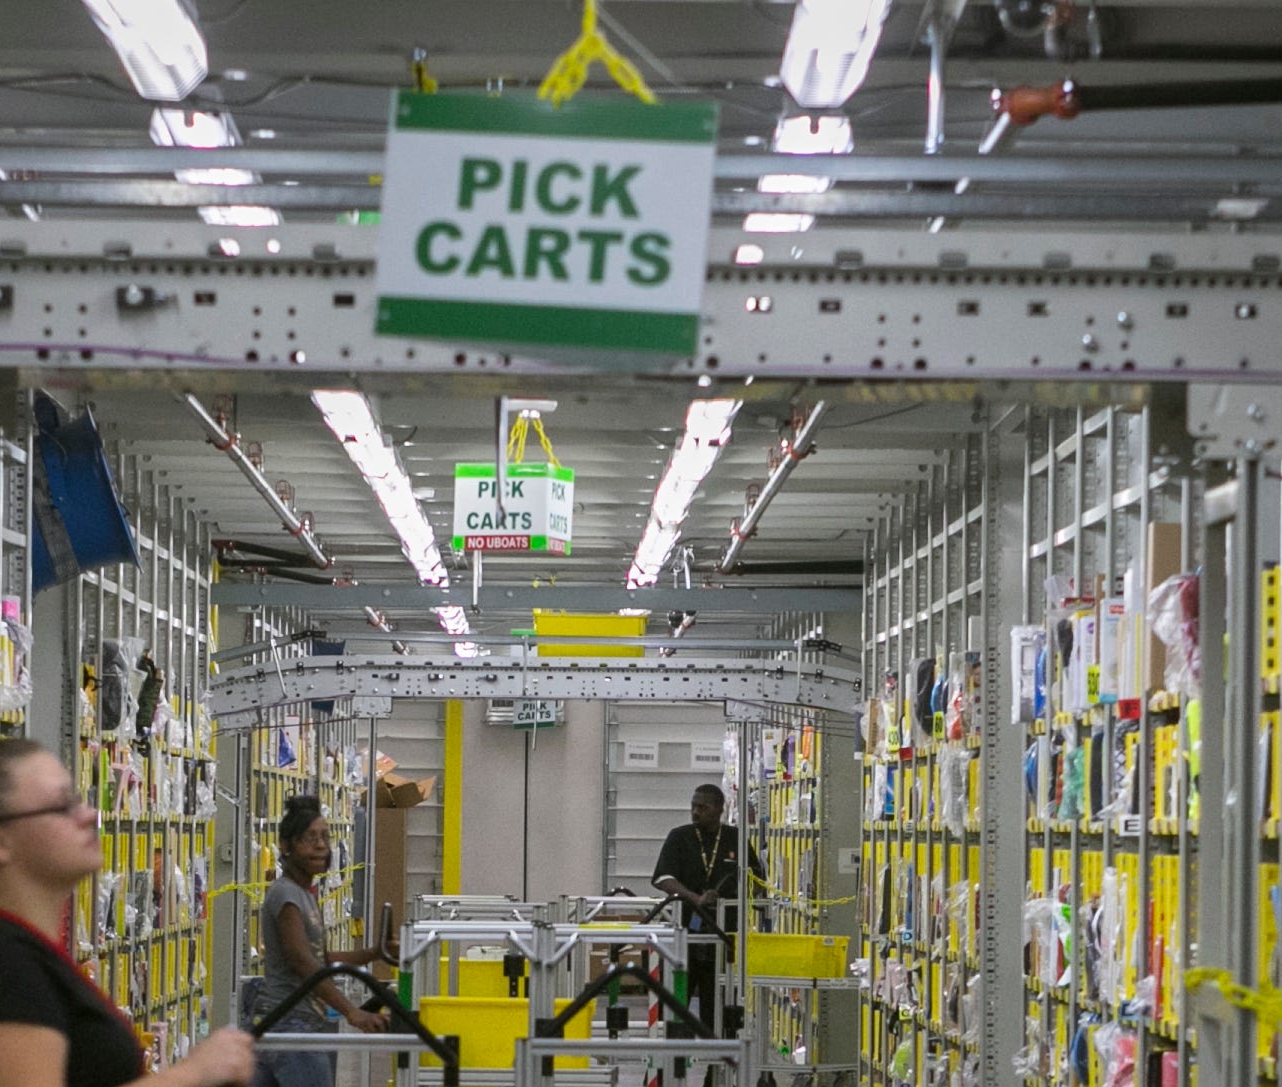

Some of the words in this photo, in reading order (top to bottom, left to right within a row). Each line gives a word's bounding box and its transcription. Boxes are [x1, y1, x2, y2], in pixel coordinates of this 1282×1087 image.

[457, 156, 643, 219] PICK
[414, 221, 672, 287] CARTS
[468, 536, 484, 548] NO
[486, 536, 529, 549] UBOATS
[1124, 819, 1138, 832] E
[903, 932, 912, 941] D
